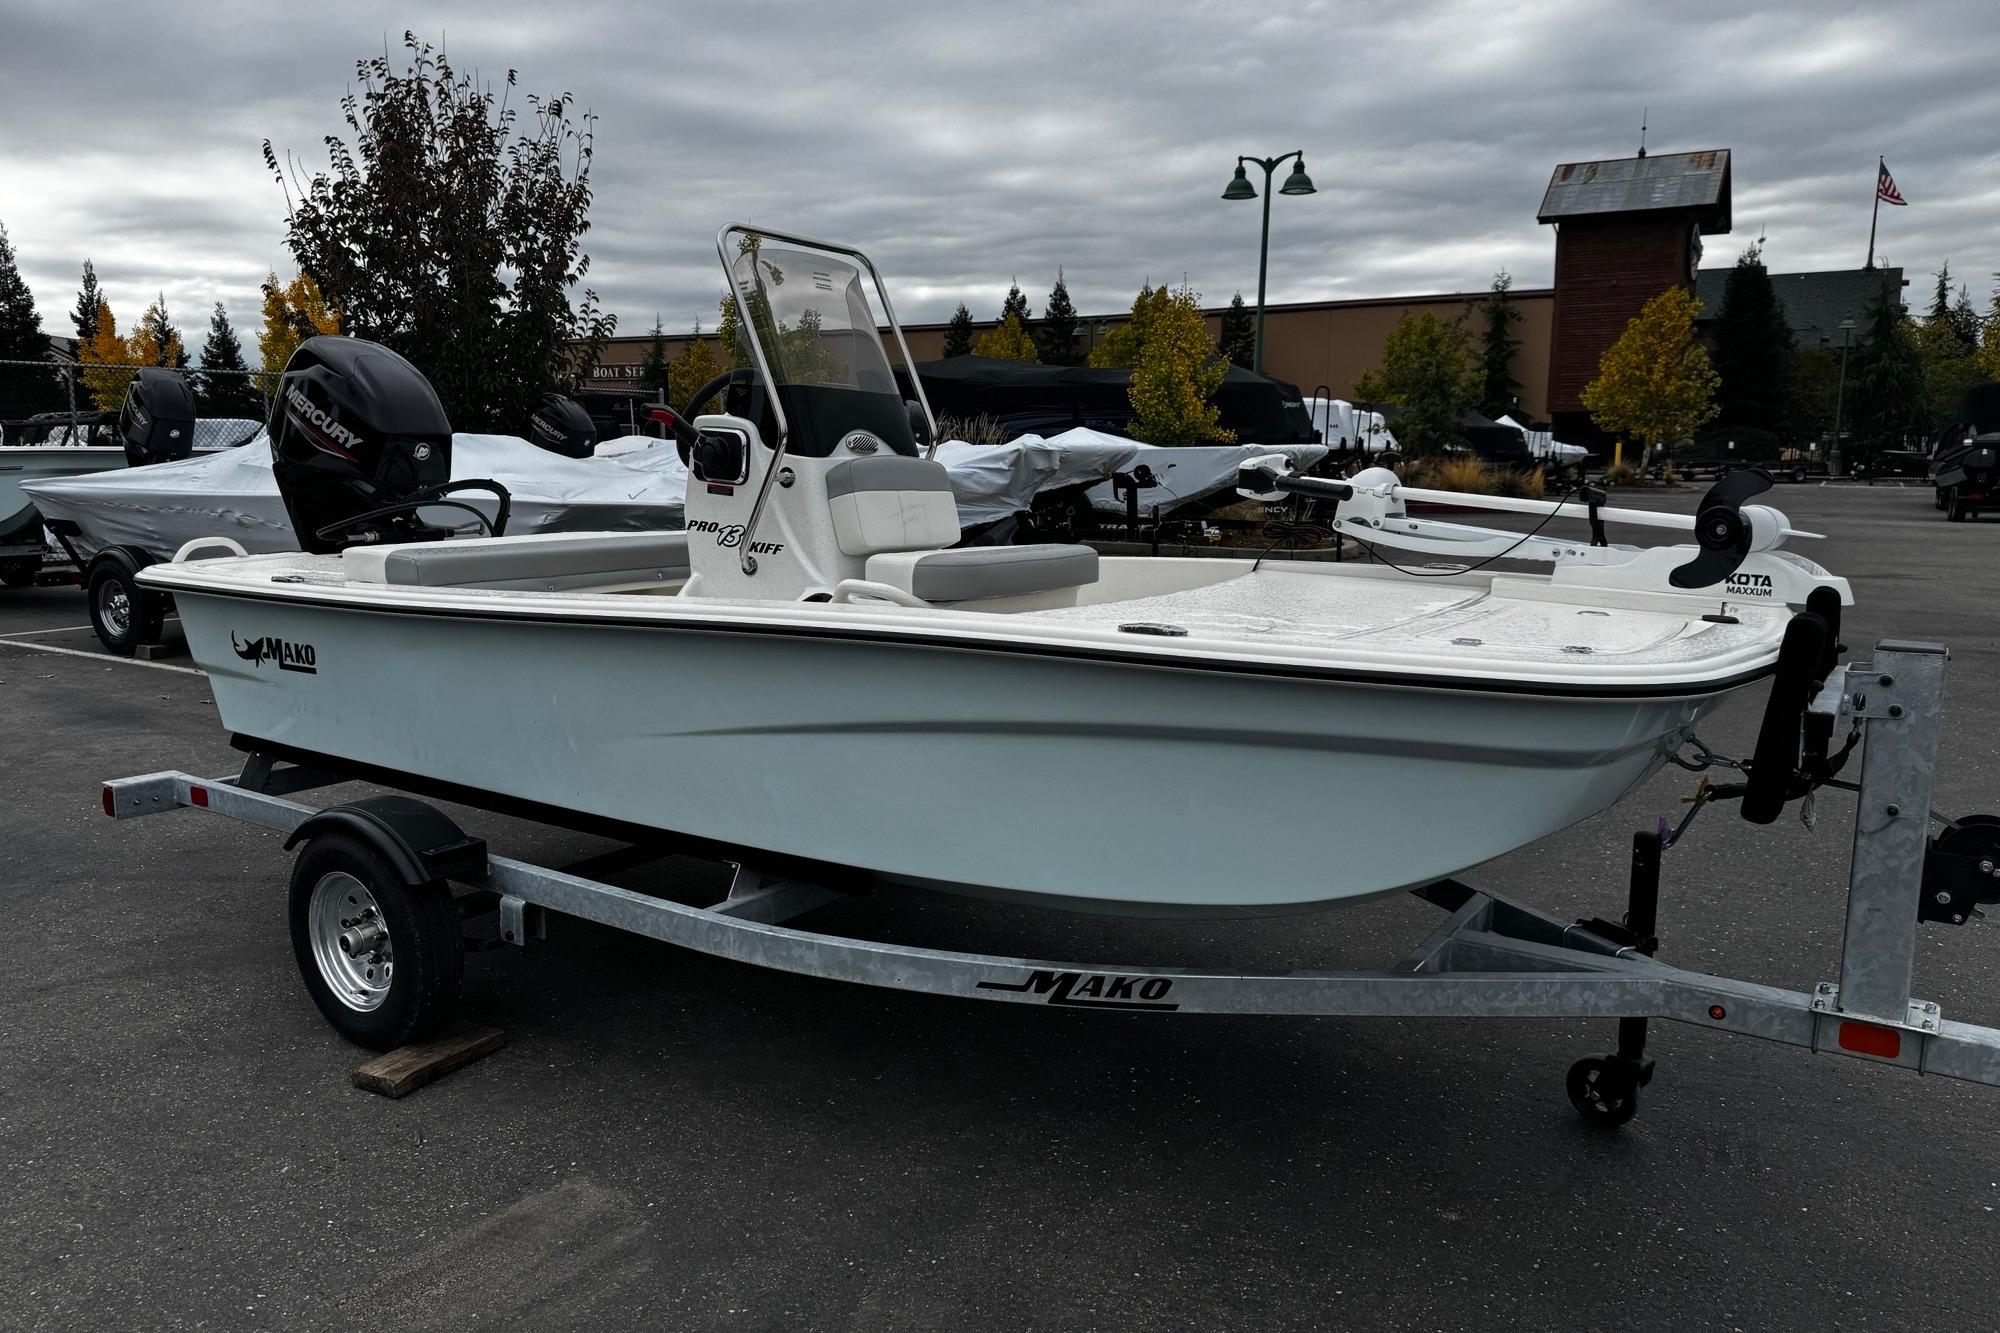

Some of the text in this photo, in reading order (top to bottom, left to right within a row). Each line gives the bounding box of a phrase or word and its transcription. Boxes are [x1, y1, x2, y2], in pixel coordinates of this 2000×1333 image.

[593, 366, 620, 378] BOAT
[285, 384, 364, 449] MERCURY
[530, 413, 568, 441] MERCURY
[687, 520, 719, 533] PRO
[749, 541, 784, 555] KIFF
[1726, 586, 1772, 597] MAXXUM
[262, 636, 317, 675] MAKO
[976, 970, 1180, 1011] MAKO
